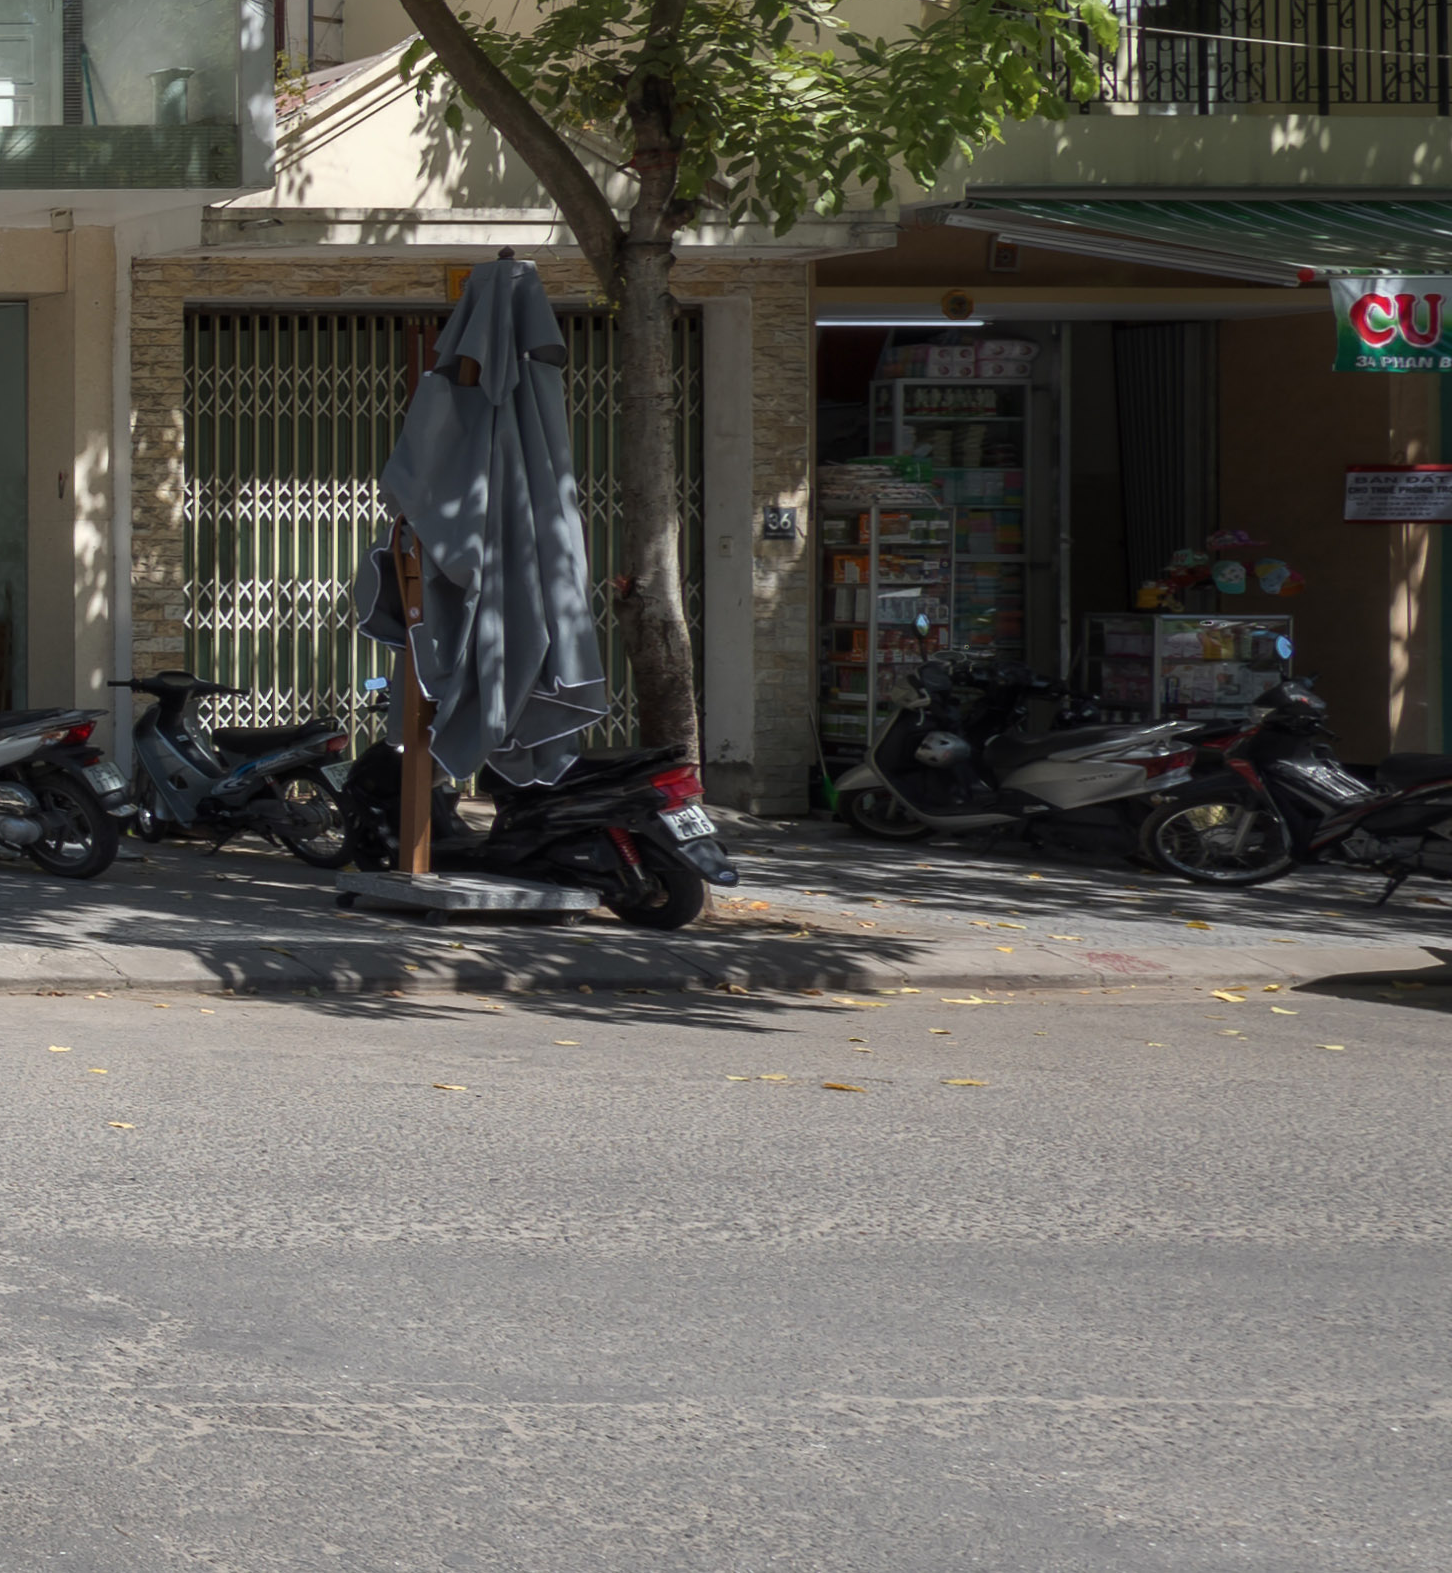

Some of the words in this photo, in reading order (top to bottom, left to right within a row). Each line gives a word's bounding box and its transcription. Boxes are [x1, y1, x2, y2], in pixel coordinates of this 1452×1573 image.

[1355, 356, 1376, 368] 34
[1380, 356, 1433, 369] PHAN
[1439, 357, 1452, 368] B
[768, 513, 791, 530] 36
